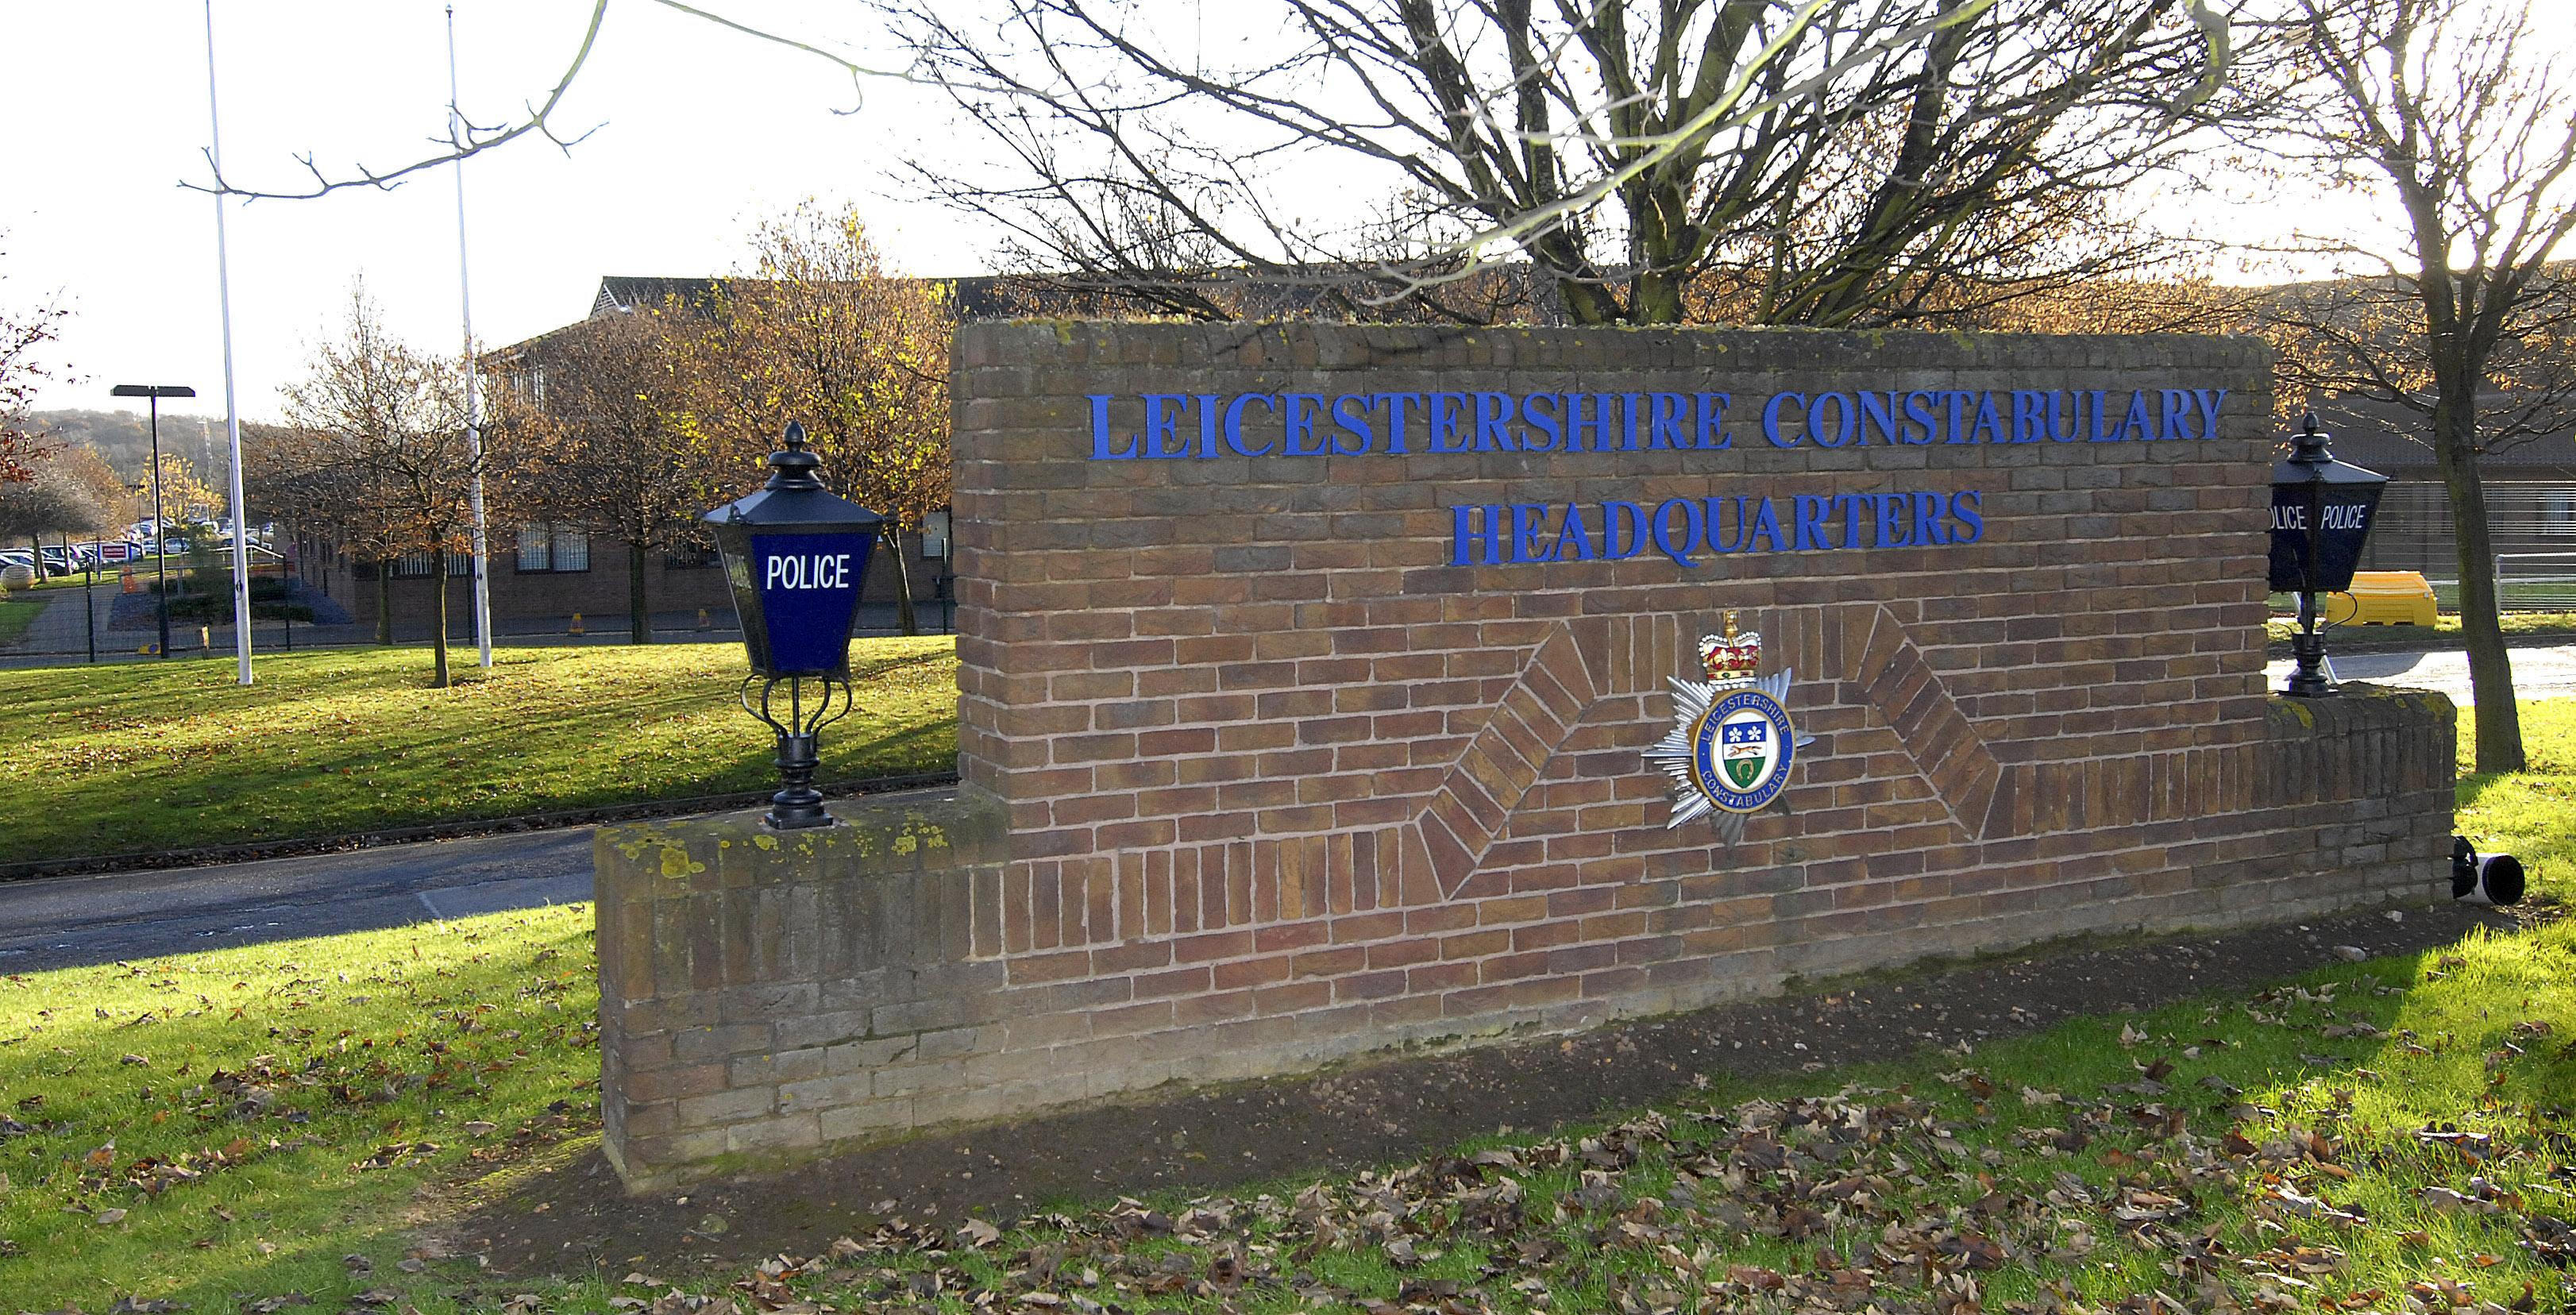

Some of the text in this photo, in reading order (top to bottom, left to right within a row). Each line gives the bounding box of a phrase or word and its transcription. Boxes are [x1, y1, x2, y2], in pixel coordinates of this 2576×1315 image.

[1086, 389, 2227, 461] LEICESTERSHIRE CONSTABULARY
[1451, 491, 1984, 568] HEADQUARTERS
[2269, 506, 2307, 530] LICE
[2320, 504, 2366, 530] POLICE
[766, 554, 850, 590] POLICE
[1702, 694, 1790, 742] LEICESTERSHIRE
[1702, 763, 1787, 808] CONSTABULARY
